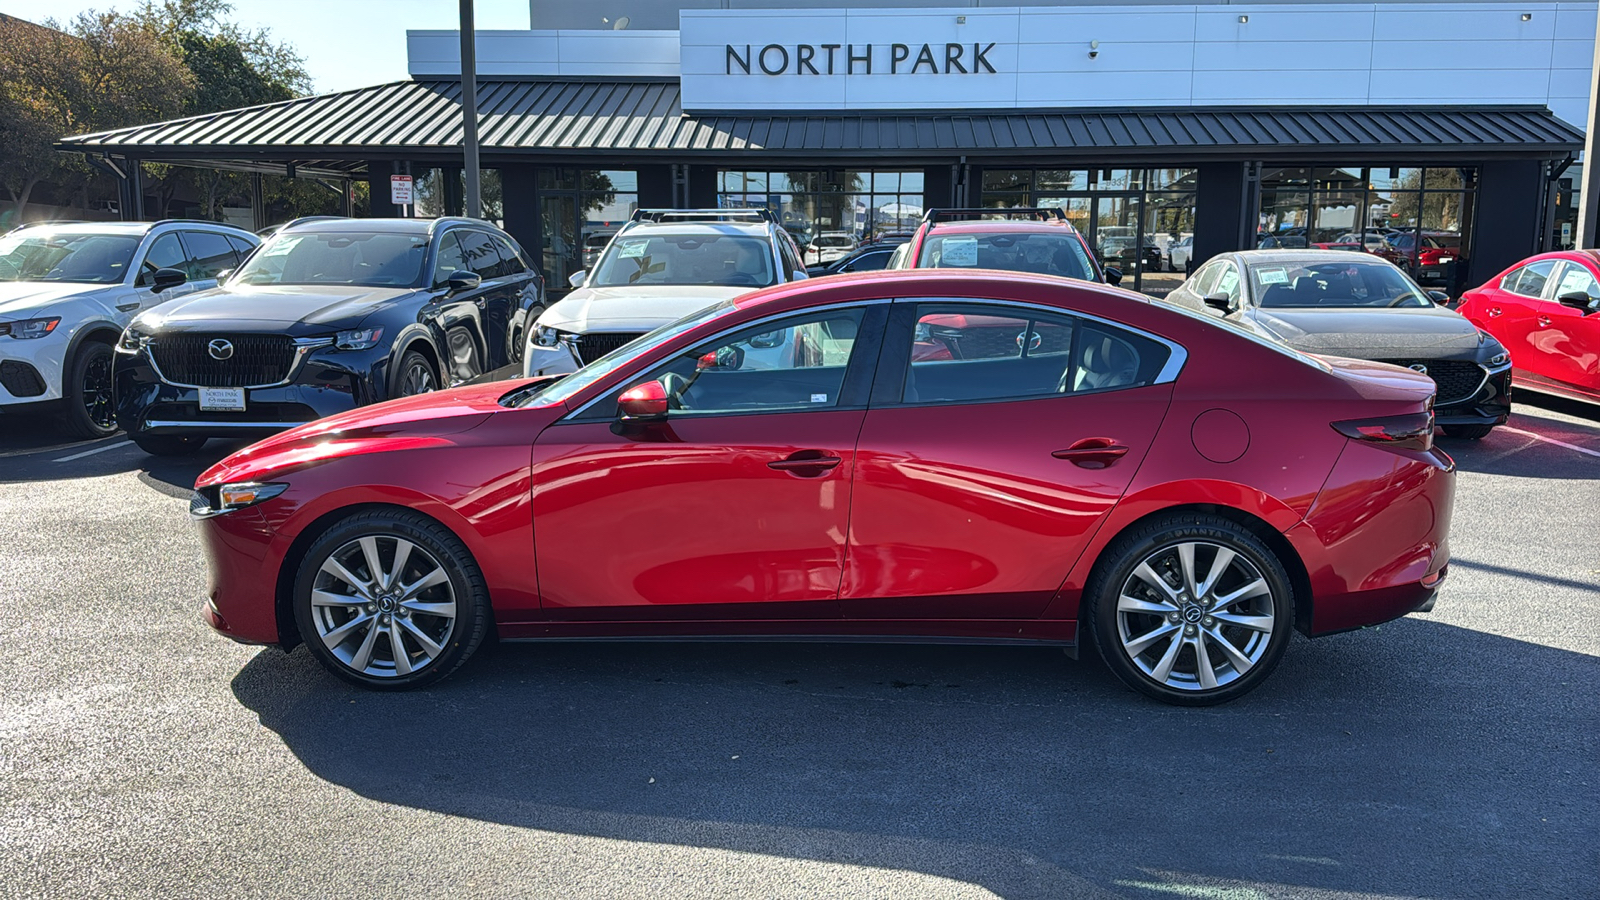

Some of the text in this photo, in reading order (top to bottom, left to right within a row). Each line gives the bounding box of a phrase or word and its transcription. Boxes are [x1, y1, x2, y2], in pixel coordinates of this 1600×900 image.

[726, 42, 997, 76] NORTH PARK
[402, 527, 450, 560] ADVANTA
[1164, 528, 1222, 540] ADVANTA
